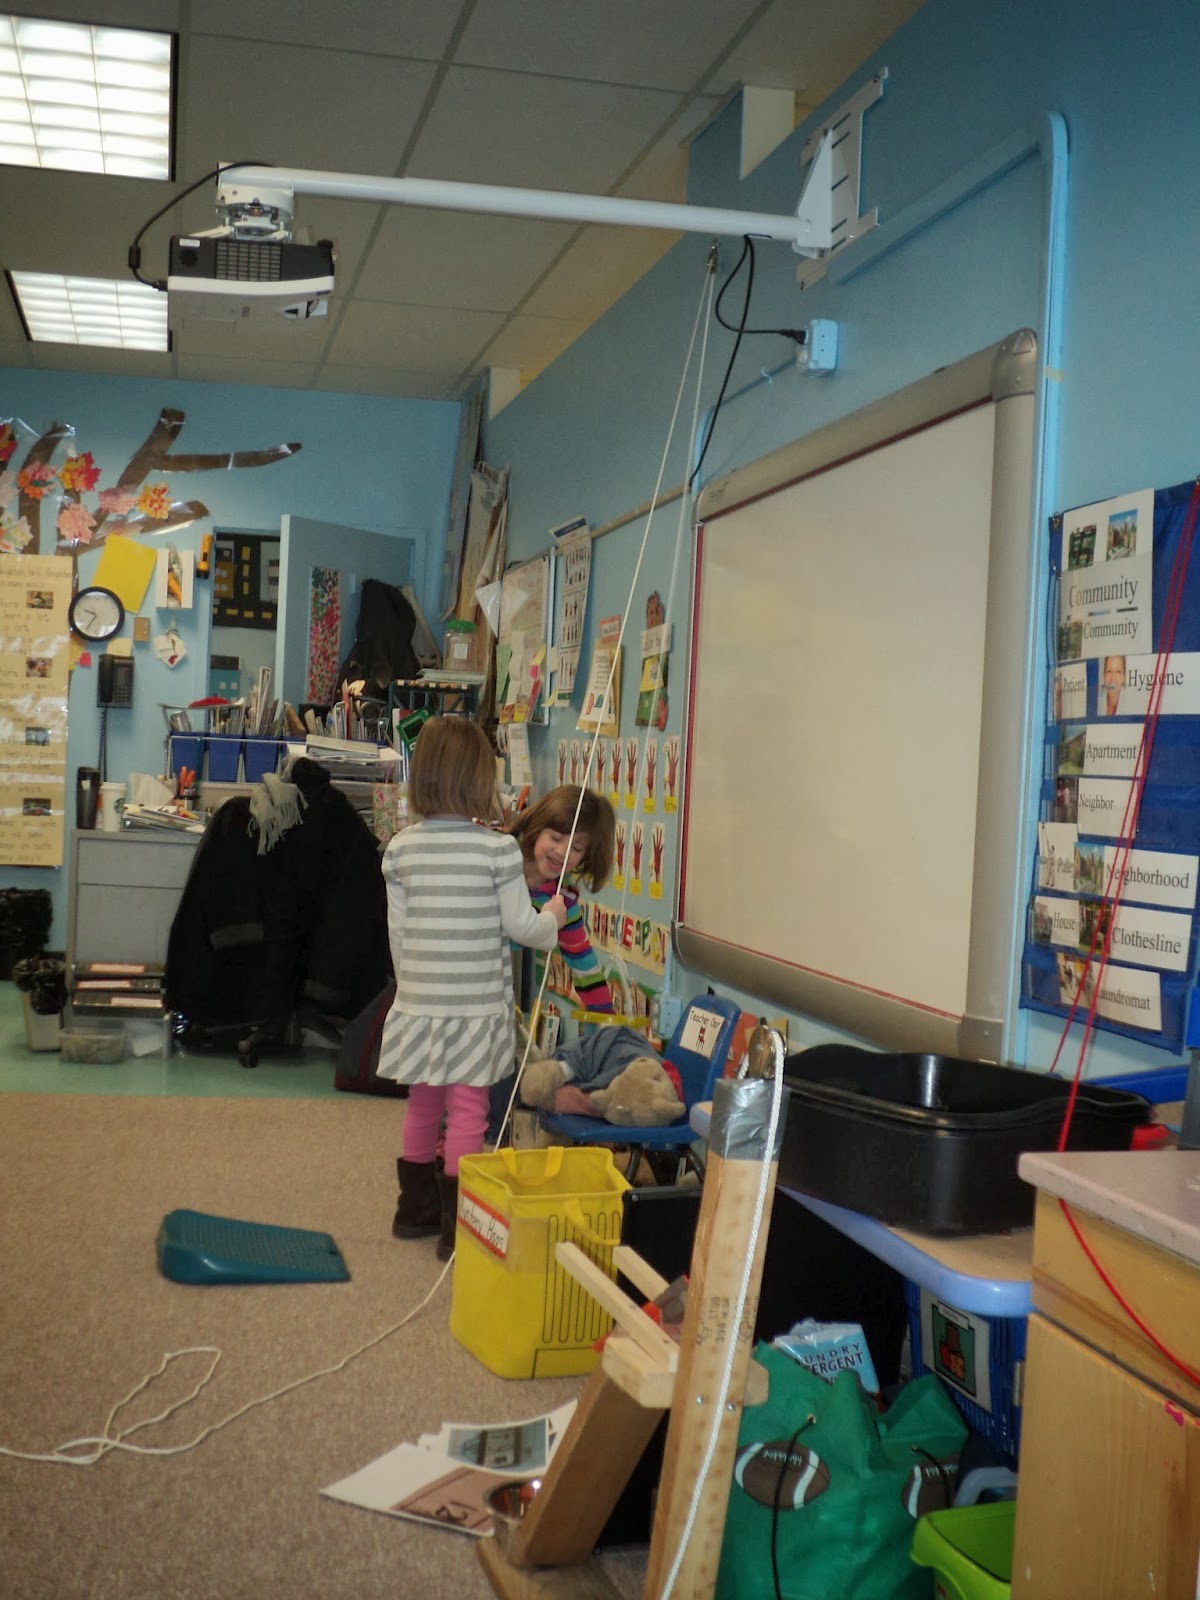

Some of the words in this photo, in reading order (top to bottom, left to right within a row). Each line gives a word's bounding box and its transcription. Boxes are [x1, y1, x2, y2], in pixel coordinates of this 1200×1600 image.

[1069, 575, 1139, 608] Community
[1083, 617, 1139, 639] Community
[1086, 744, 1137, 762] Apartment
[1079, 794, 1115, 812] Neighbor
[1057, 856, 1073, 877] Pulle
[1106, 863, 1190, 888] Neghborhood
[1053, 912, 1076, 931] House
[1112, 927, 1182, 954] Clothesline
[1099, 989, 1151, 1010] aundromat
[690, 1010, 710, 1026] Teacher
